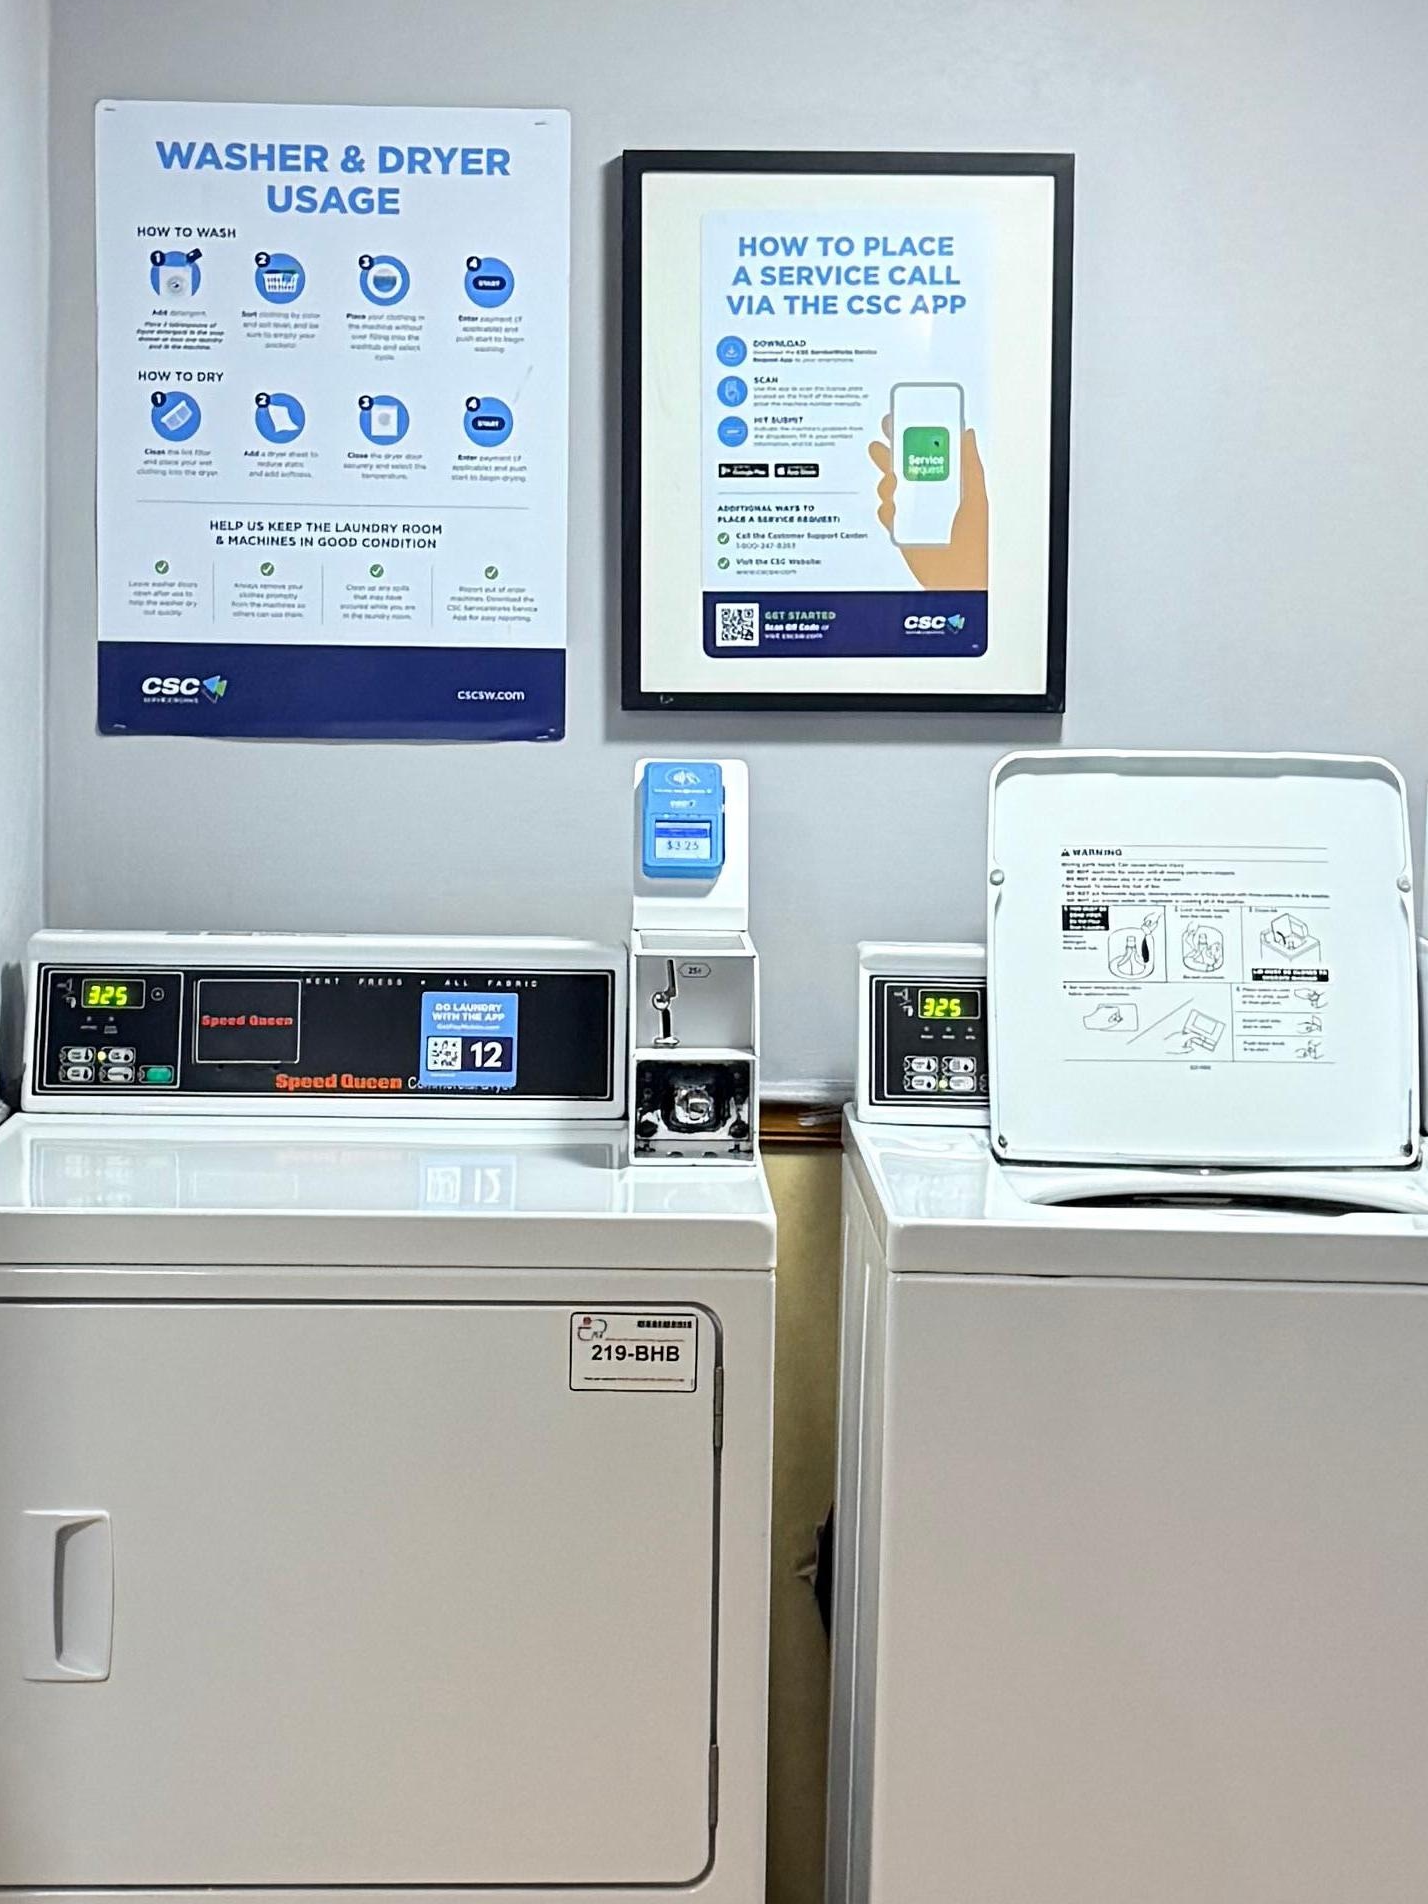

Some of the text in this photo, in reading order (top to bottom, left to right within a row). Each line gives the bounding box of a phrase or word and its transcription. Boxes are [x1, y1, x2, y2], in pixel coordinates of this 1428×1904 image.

[155, 141, 512, 176] WASHER & DRYER
[267, 185, 400, 215] USAGE
[137, 226, 237, 239] HOW TO WASH
[738, 236, 955, 257] HOW TO PLACE
[257, 254, 268, 265] 2
[468, 257, 479, 269] 4
[732, 265, 961, 286] A SERVICE CALL
[726, 294, 967, 316] VIA THE CSC APP
[753, 340, 807, 348] DOWNLOAD
[137, 370, 225, 382] HOW TO DRY
[754, 376, 779, 384] SCAN
[257, 395, 268, 406] 2
[908, 454, 945, 465] Service
[210, 520, 443, 535] HELP US KEEP THE LAUNDRY ROOM
[215, 535, 438, 549] & MACHINES IN GOOD CONDITION
[764, 611, 837, 621] GET STARTED
[904, 615, 947, 630] CSC
[141, 676, 201, 696] CSC
[457, 689, 526, 701] cscsw.com
[1072, 848, 1123, 857] WARNING
[358, 977, 538, 988] PRESS ALL FABRIC
[87, 985, 128, 1006] 325
[435, 1003, 503, 1013] DO LAUNDRY
[923, 997, 962, 1017] 325
[200, 1014, 294, 1027] Speed Queen
[431, 1011, 506, 1023] WITH THE APP
[470, 1041, 504, 1068] 12
[275, 1072, 337, 1092] Speed
[339, 1072, 404, 1091] Queen
[591, 1344, 680, 1362] 219-BHB
